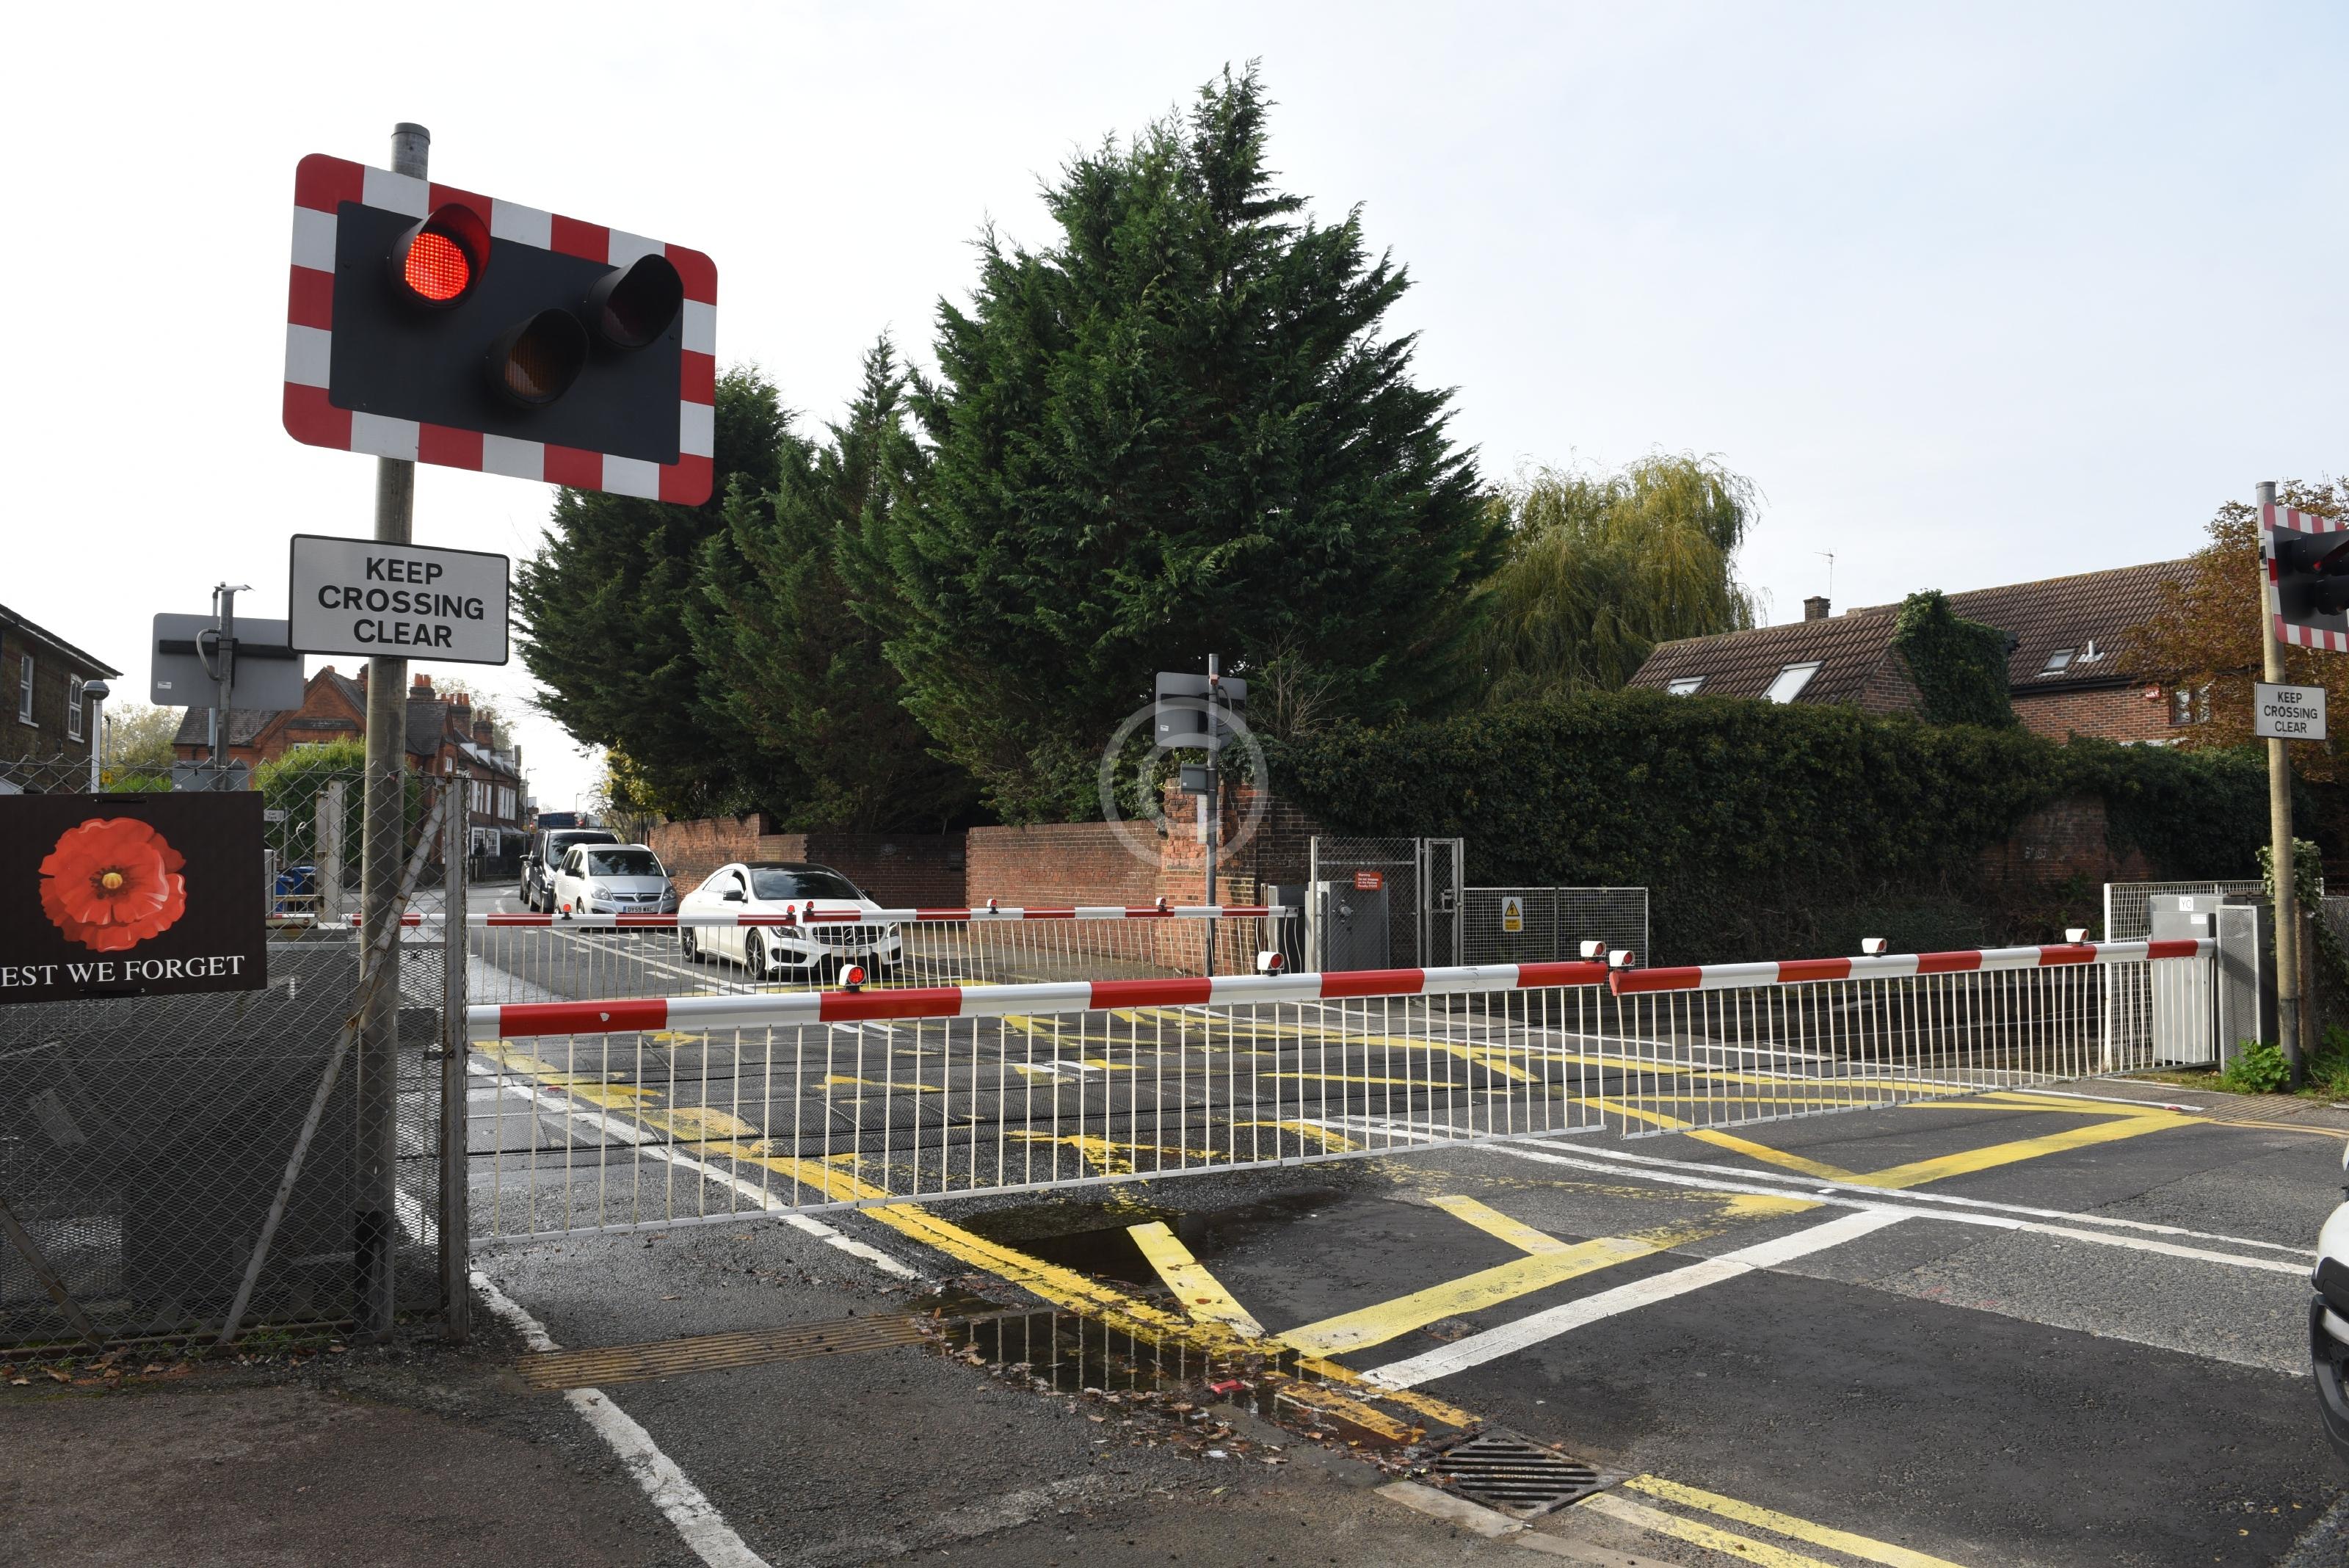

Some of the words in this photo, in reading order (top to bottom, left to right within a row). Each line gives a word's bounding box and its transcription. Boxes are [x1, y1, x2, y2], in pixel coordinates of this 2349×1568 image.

[367, 557, 443, 584] KEEP
[318, 585, 484, 620] CROSSING
[354, 620, 452, 647] CLEAR
[2278, 692, 2302, 703] KEEP
[2264, 705, 2317, 719] CROSSING
[2275, 721, 2307, 733] CLEAR
[2182, 899, 2191, 909] YO
[0, 965, 58, 987] EST
[66, 962, 114, 984] WE
[124, 956, 244, 981] FORGET
